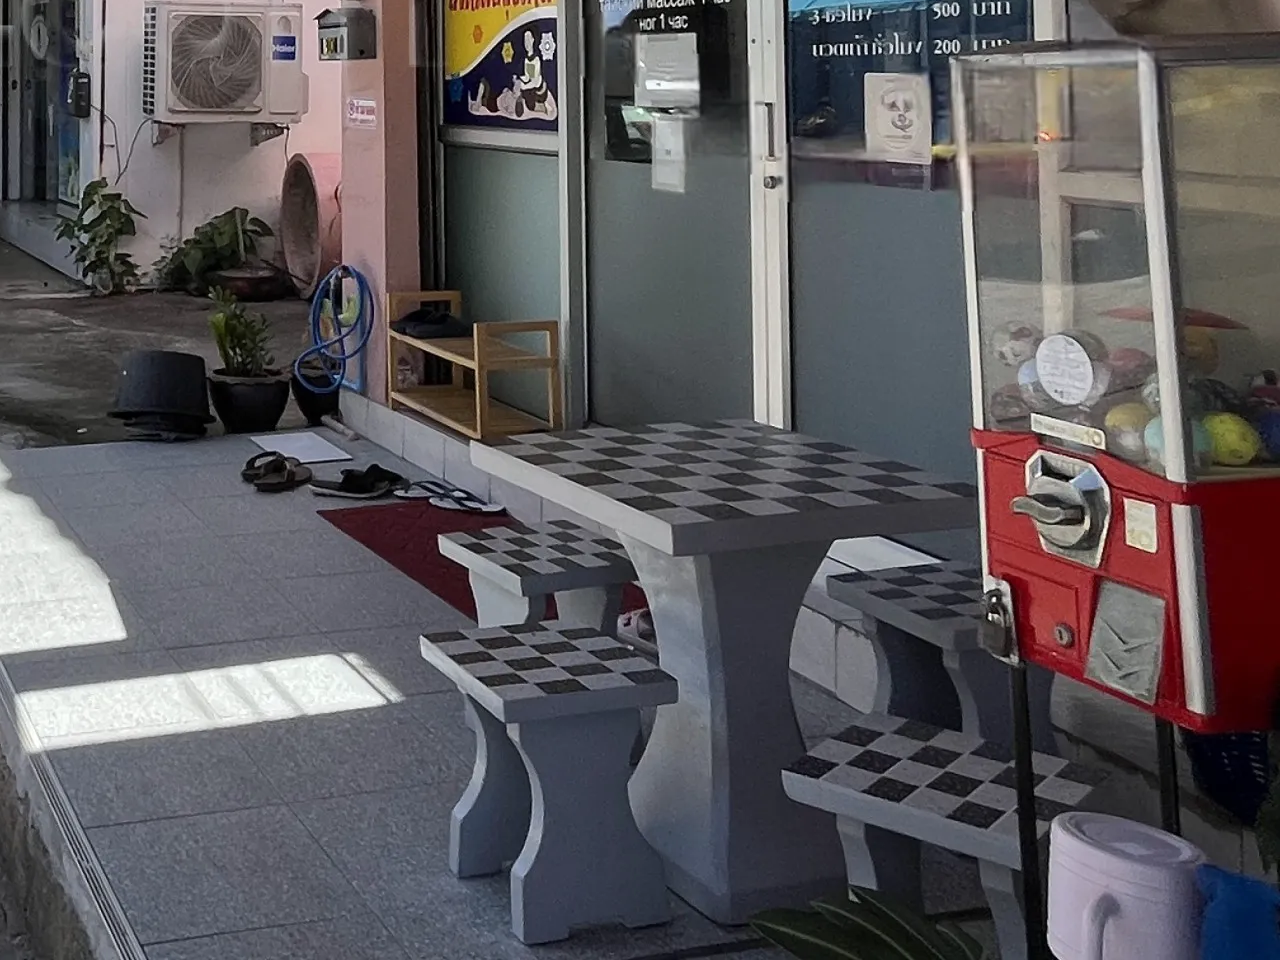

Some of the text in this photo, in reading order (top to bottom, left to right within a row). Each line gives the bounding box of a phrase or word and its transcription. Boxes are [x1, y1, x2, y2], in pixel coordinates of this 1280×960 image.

[933, 2, 960, 19] 500
[972, 0, 1011, 16] บาท
[660, 13, 665, 29] 1
[668, 15, 688, 29] час
[933, 39, 961, 54] 200
